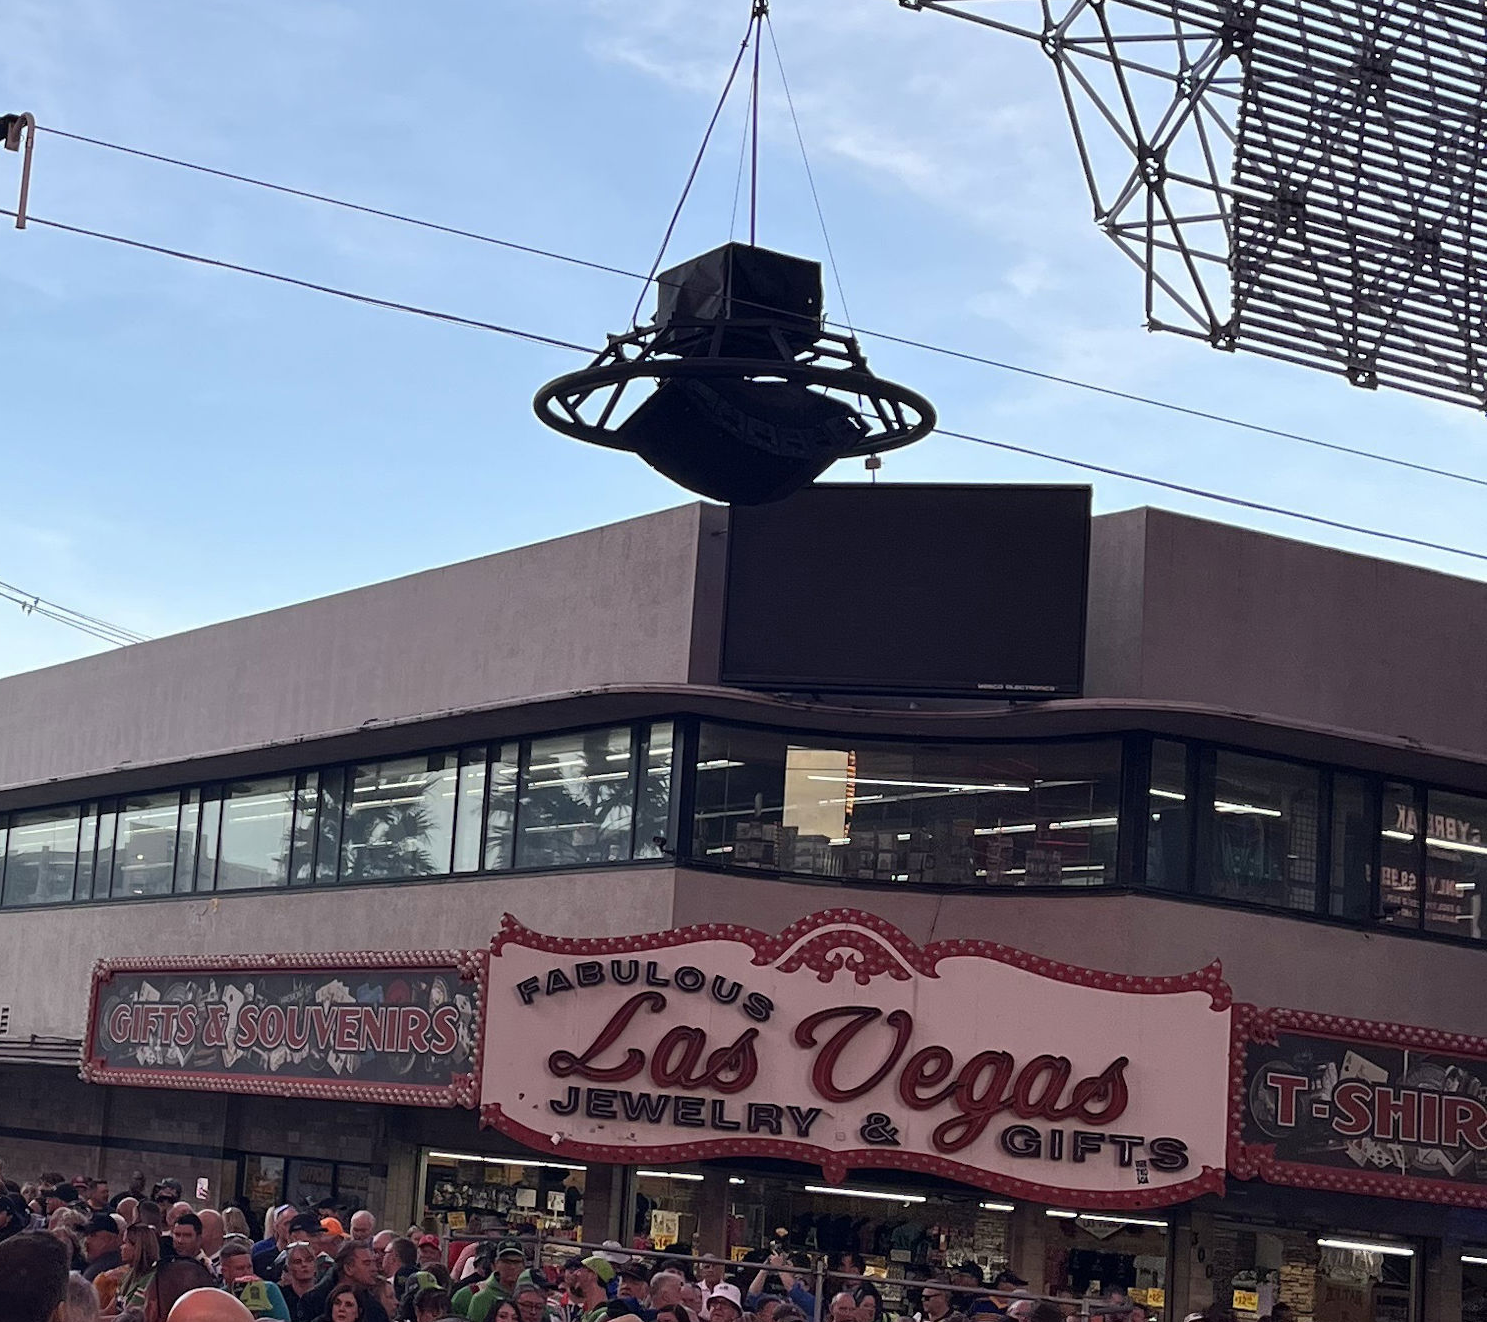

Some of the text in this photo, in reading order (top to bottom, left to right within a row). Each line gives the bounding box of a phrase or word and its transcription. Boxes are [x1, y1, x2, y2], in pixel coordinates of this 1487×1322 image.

[516, 959, 775, 1023] FABULOUS
[110, 1004, 459, 1055] GIFTS & SOUVENIRS
[548, 991, 1130, 1154] Las Vegas
[550, 1086, 823, 1139] JEWELRY
[858, 1113, 902, 1146] &
[1000, 1124, 1190, 1173] GIFTS
